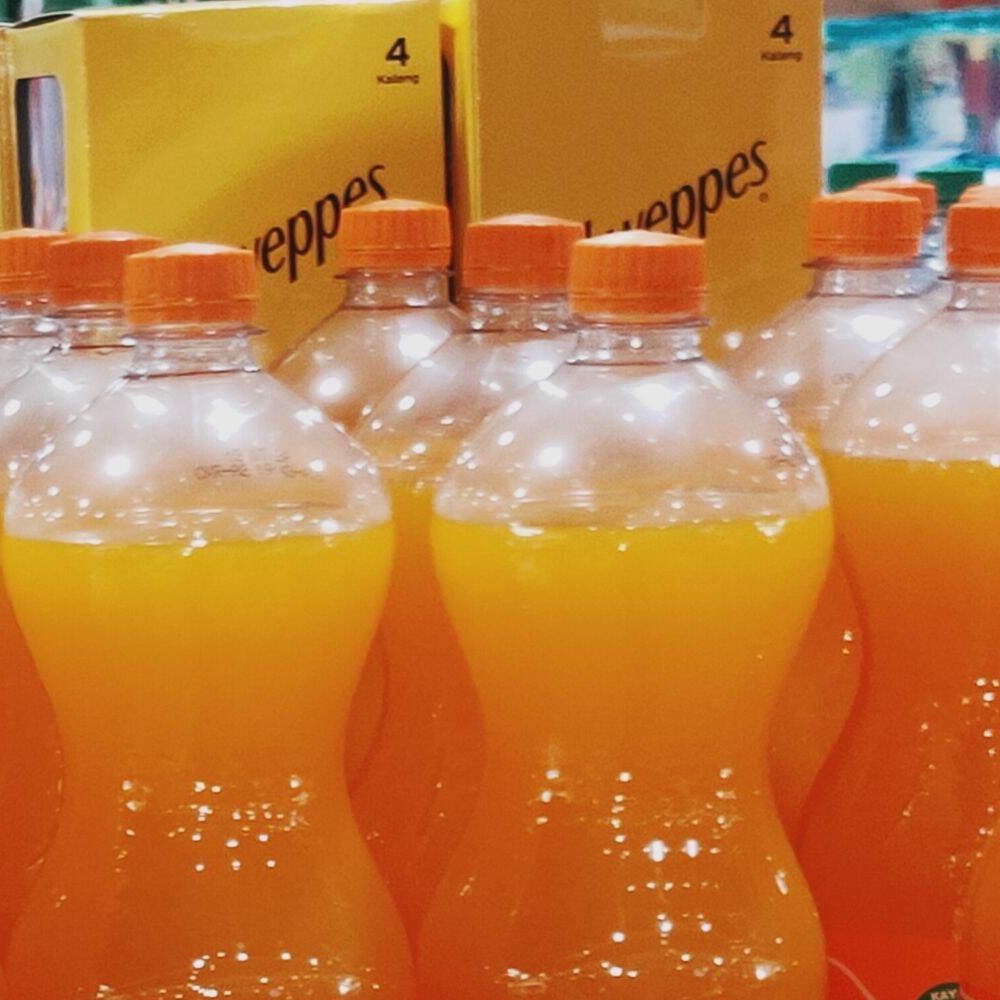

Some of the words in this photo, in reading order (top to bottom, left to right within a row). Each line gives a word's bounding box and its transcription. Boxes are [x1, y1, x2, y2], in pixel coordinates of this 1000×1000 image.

[386, 37, 411, 66] 4
[770, 15, 794, 44] 4
[584, 140, 769, 239] eppes
[254, 165, 387, 284] eppes
